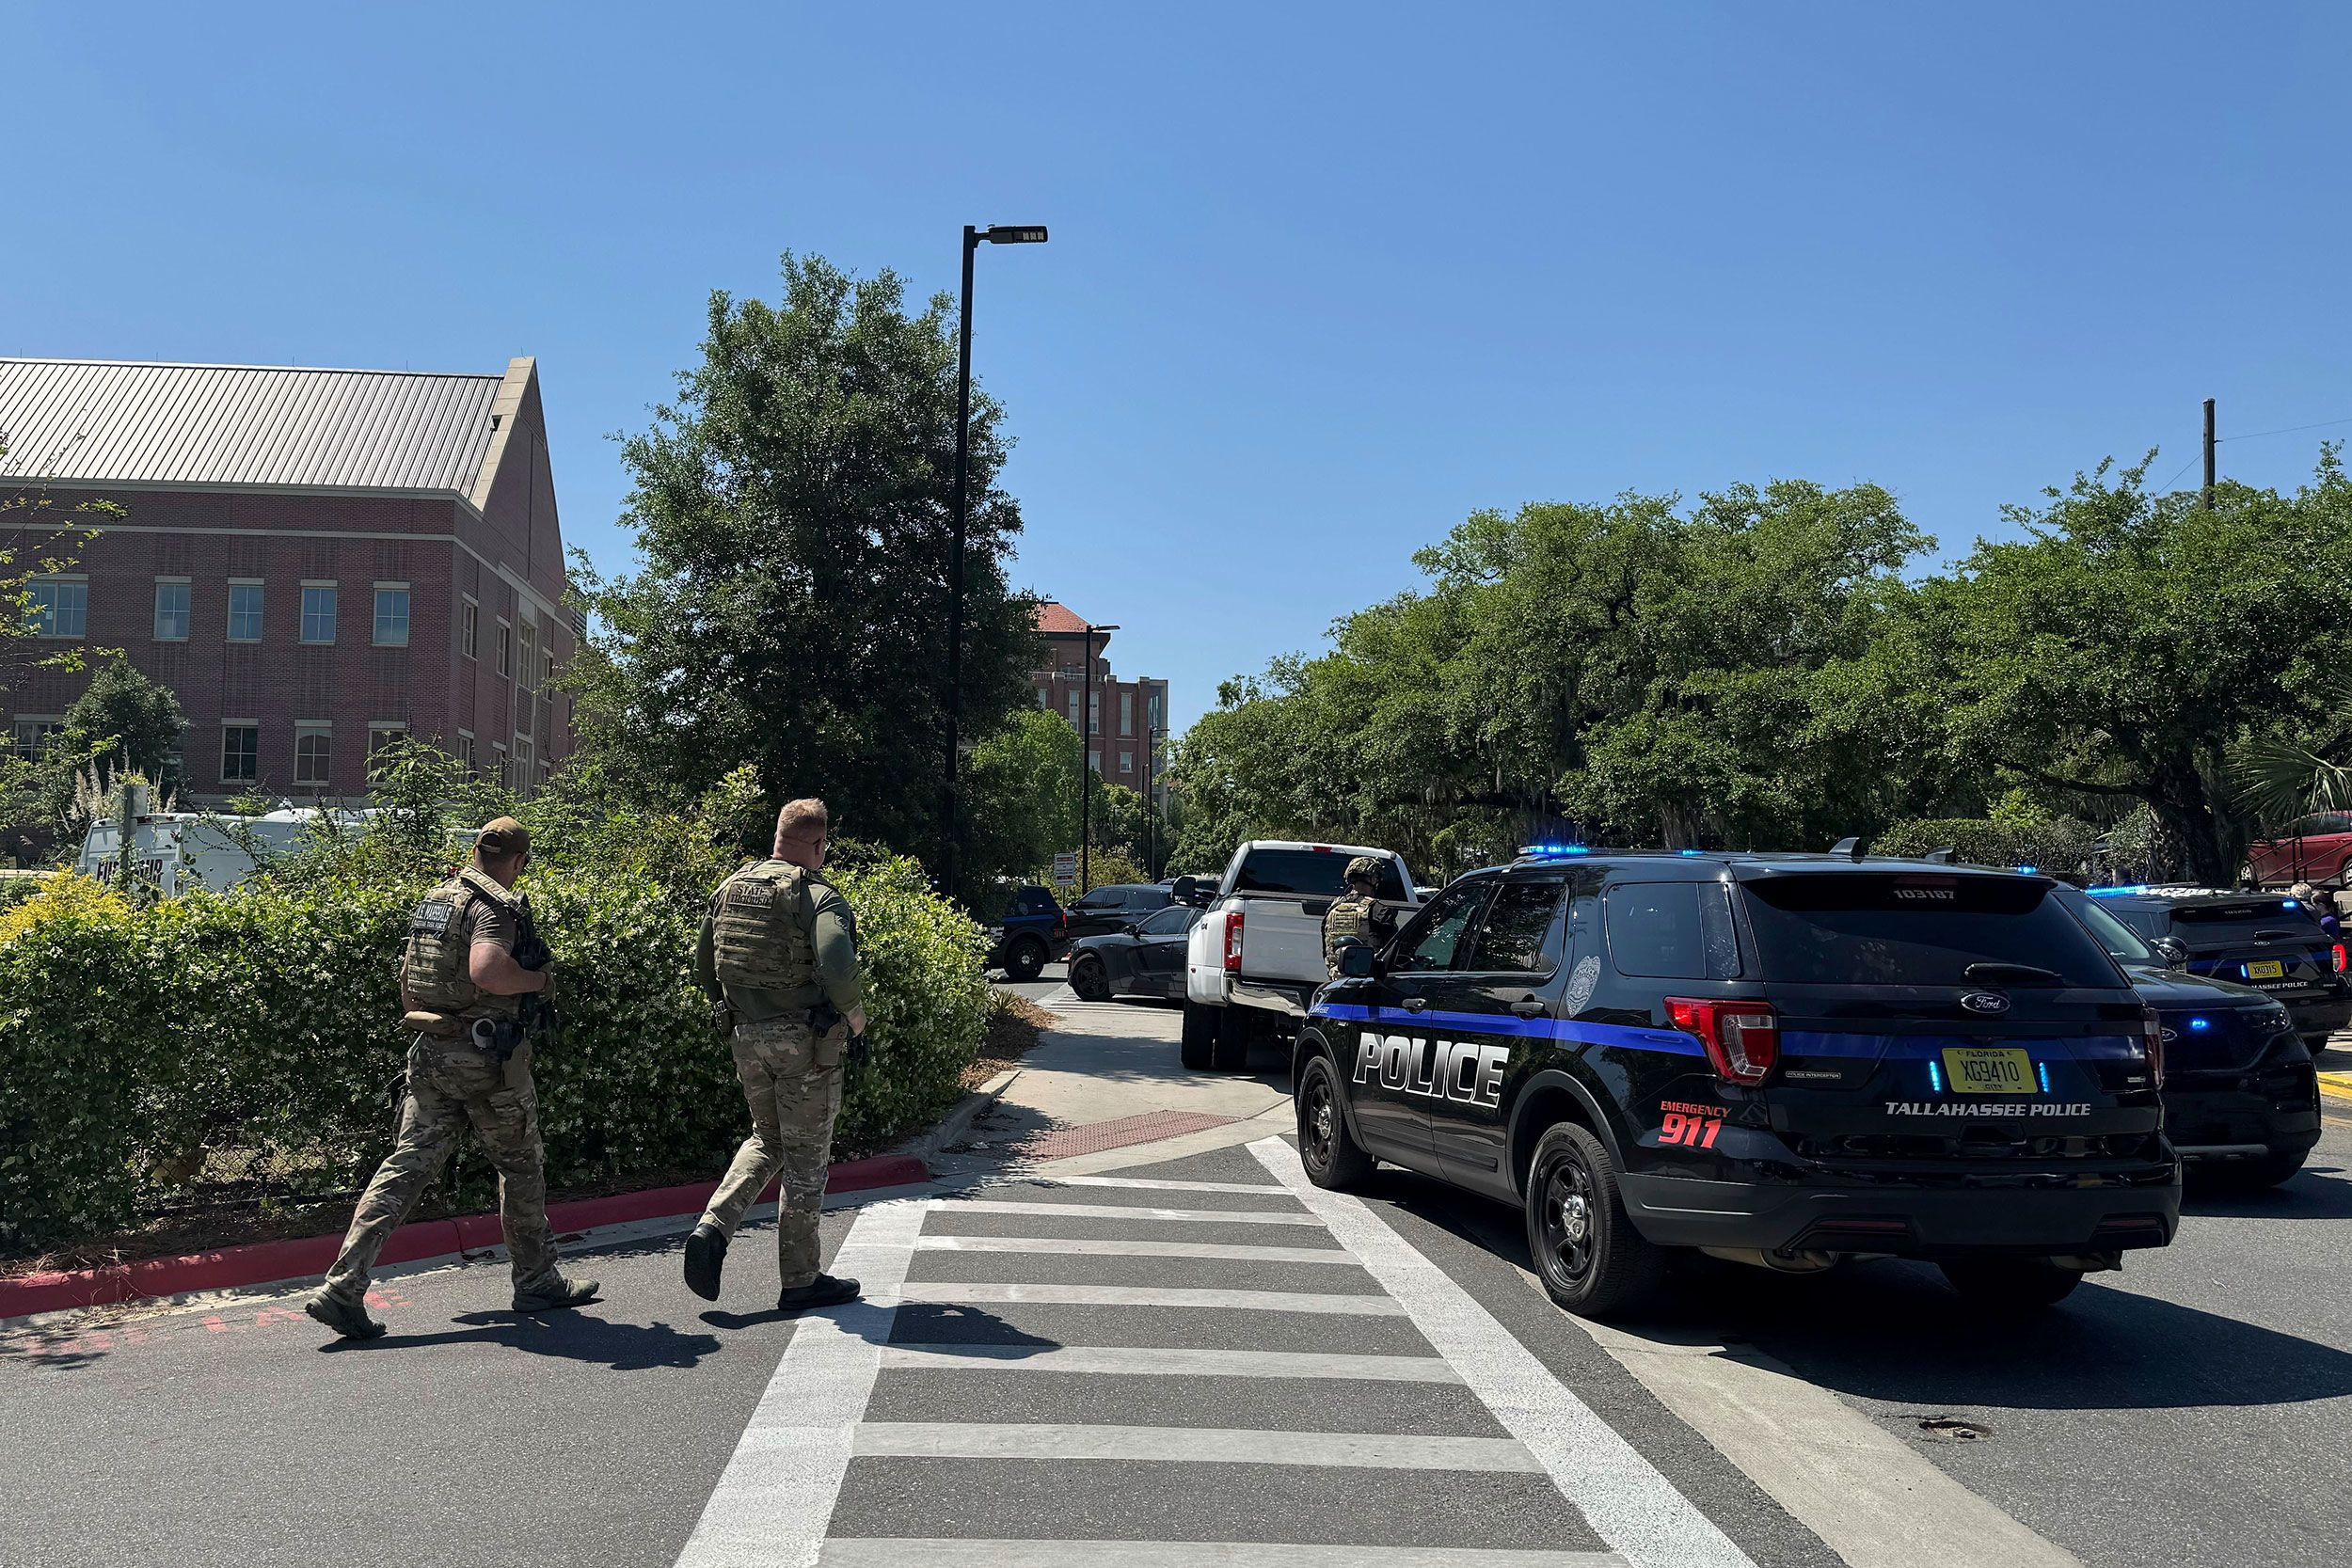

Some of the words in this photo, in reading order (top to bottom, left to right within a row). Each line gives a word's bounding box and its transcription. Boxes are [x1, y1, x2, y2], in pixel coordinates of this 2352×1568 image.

[1893, 889, 1954, 899] 103187
[2281, 980, 2309, 989] POLICE
[1976, 995, 2001, 1009] Ford
[1355, 1031, 1510, 1109] POLICE
[1960, 1060, 2020, 1083] XG9410
[1660, 1101, 1732, 1118] EMERGENCY
[1884, 1101, 2026, 1117] TALLAHASSEE
[2029, 1103, 2091, 1117] POLICE
[1658, 1113, 1722, 1148] 911
